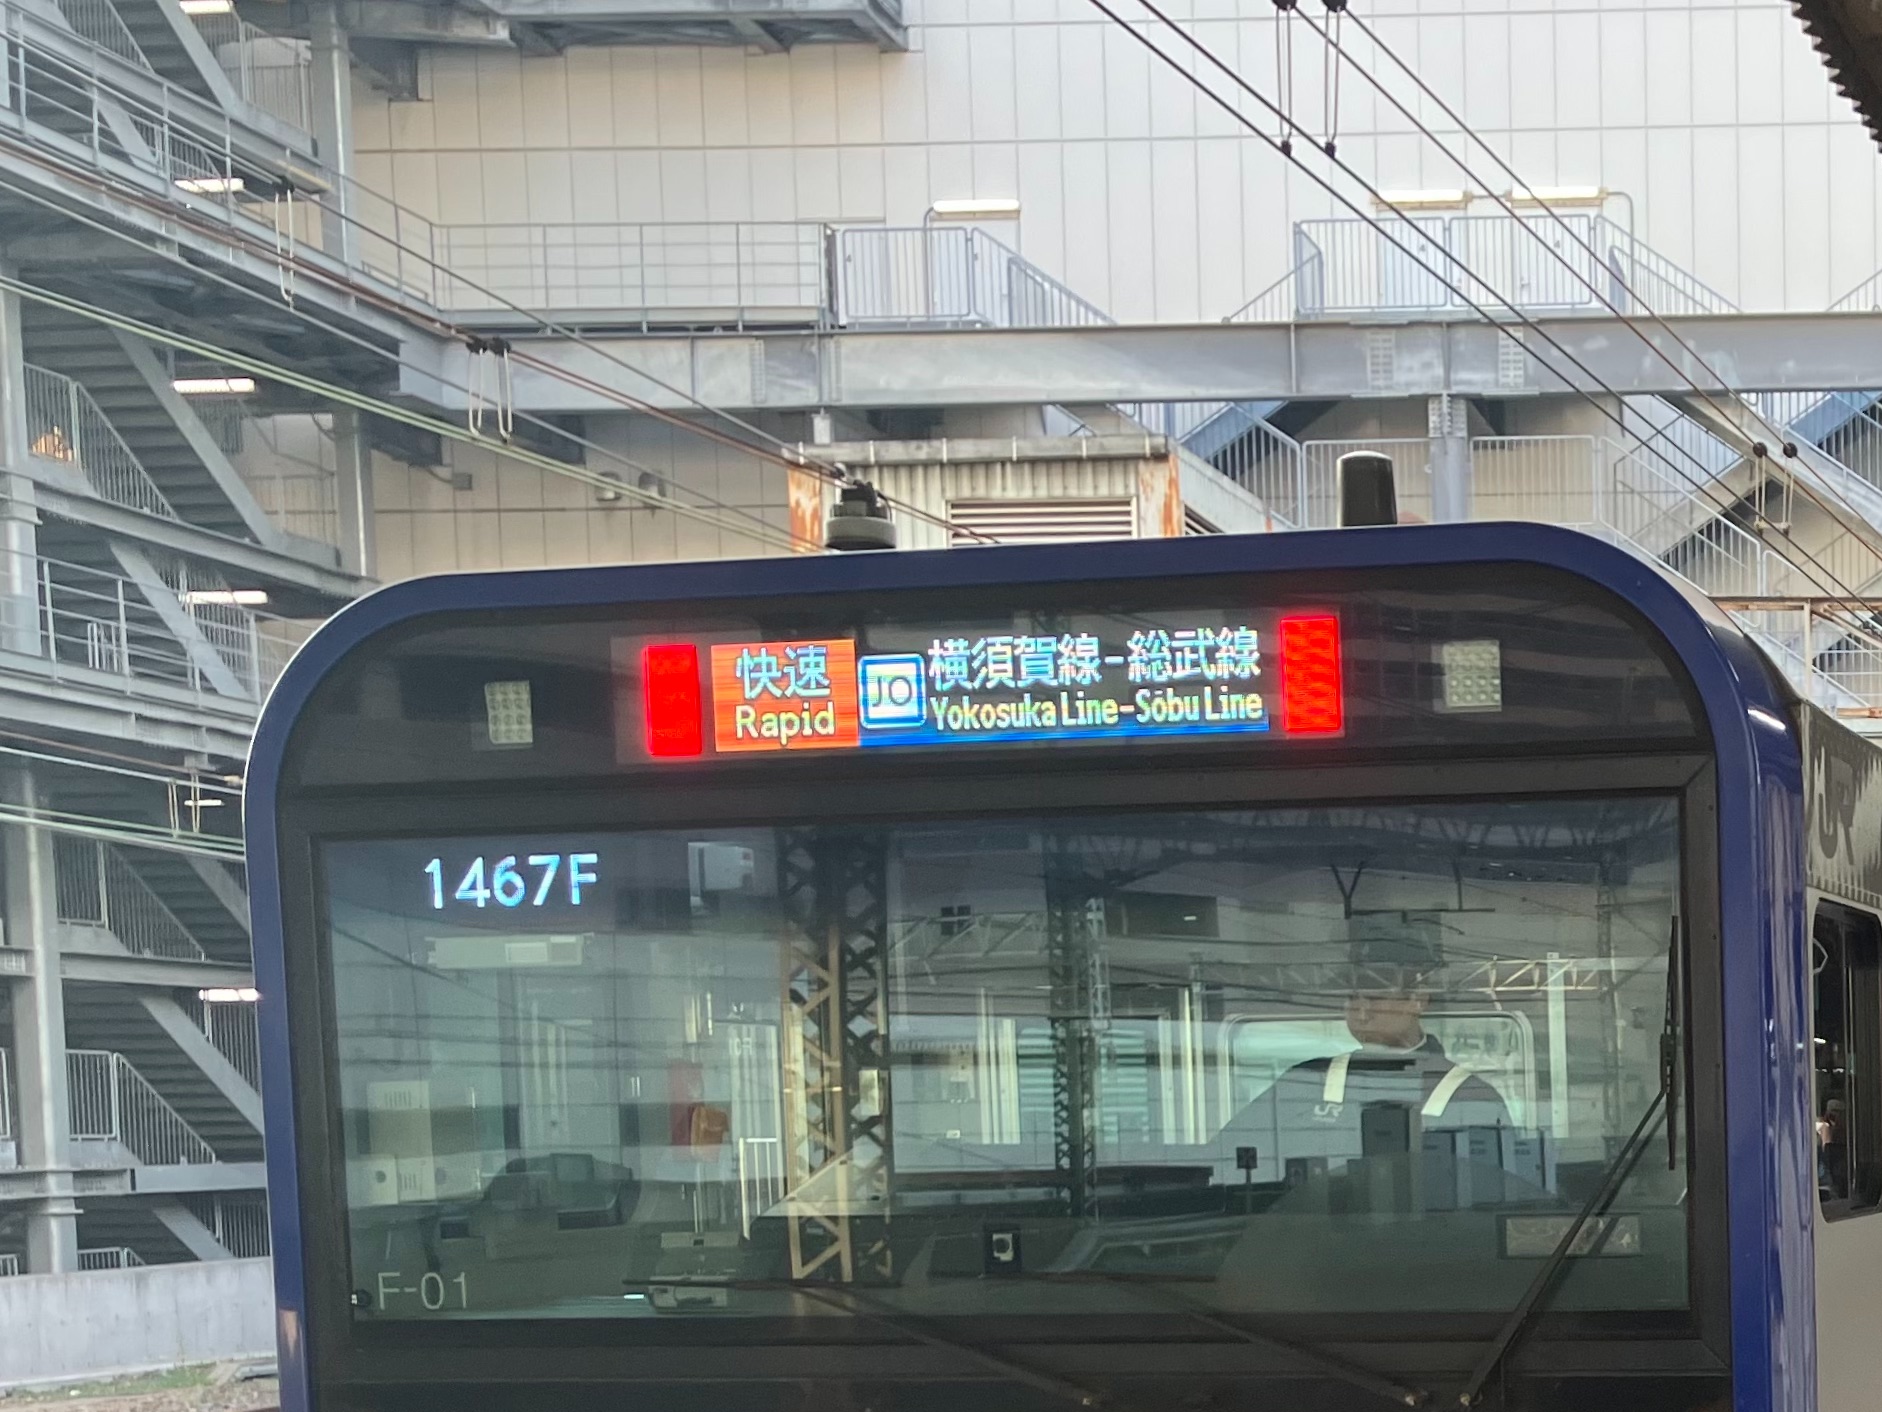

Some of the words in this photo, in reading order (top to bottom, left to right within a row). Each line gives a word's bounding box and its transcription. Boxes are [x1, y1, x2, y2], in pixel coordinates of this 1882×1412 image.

[735, 645, 831, 699] 快速
[871, 675, 913, 707] JO
[735, 701, 835, 746] Rapid
[930, 693, 1057, 730] Yokosuka
[1204, 686, 1263, 720] Line
[424, 852, 599, 909] 1467F
[377, 1271, 468, 1311] F-01
